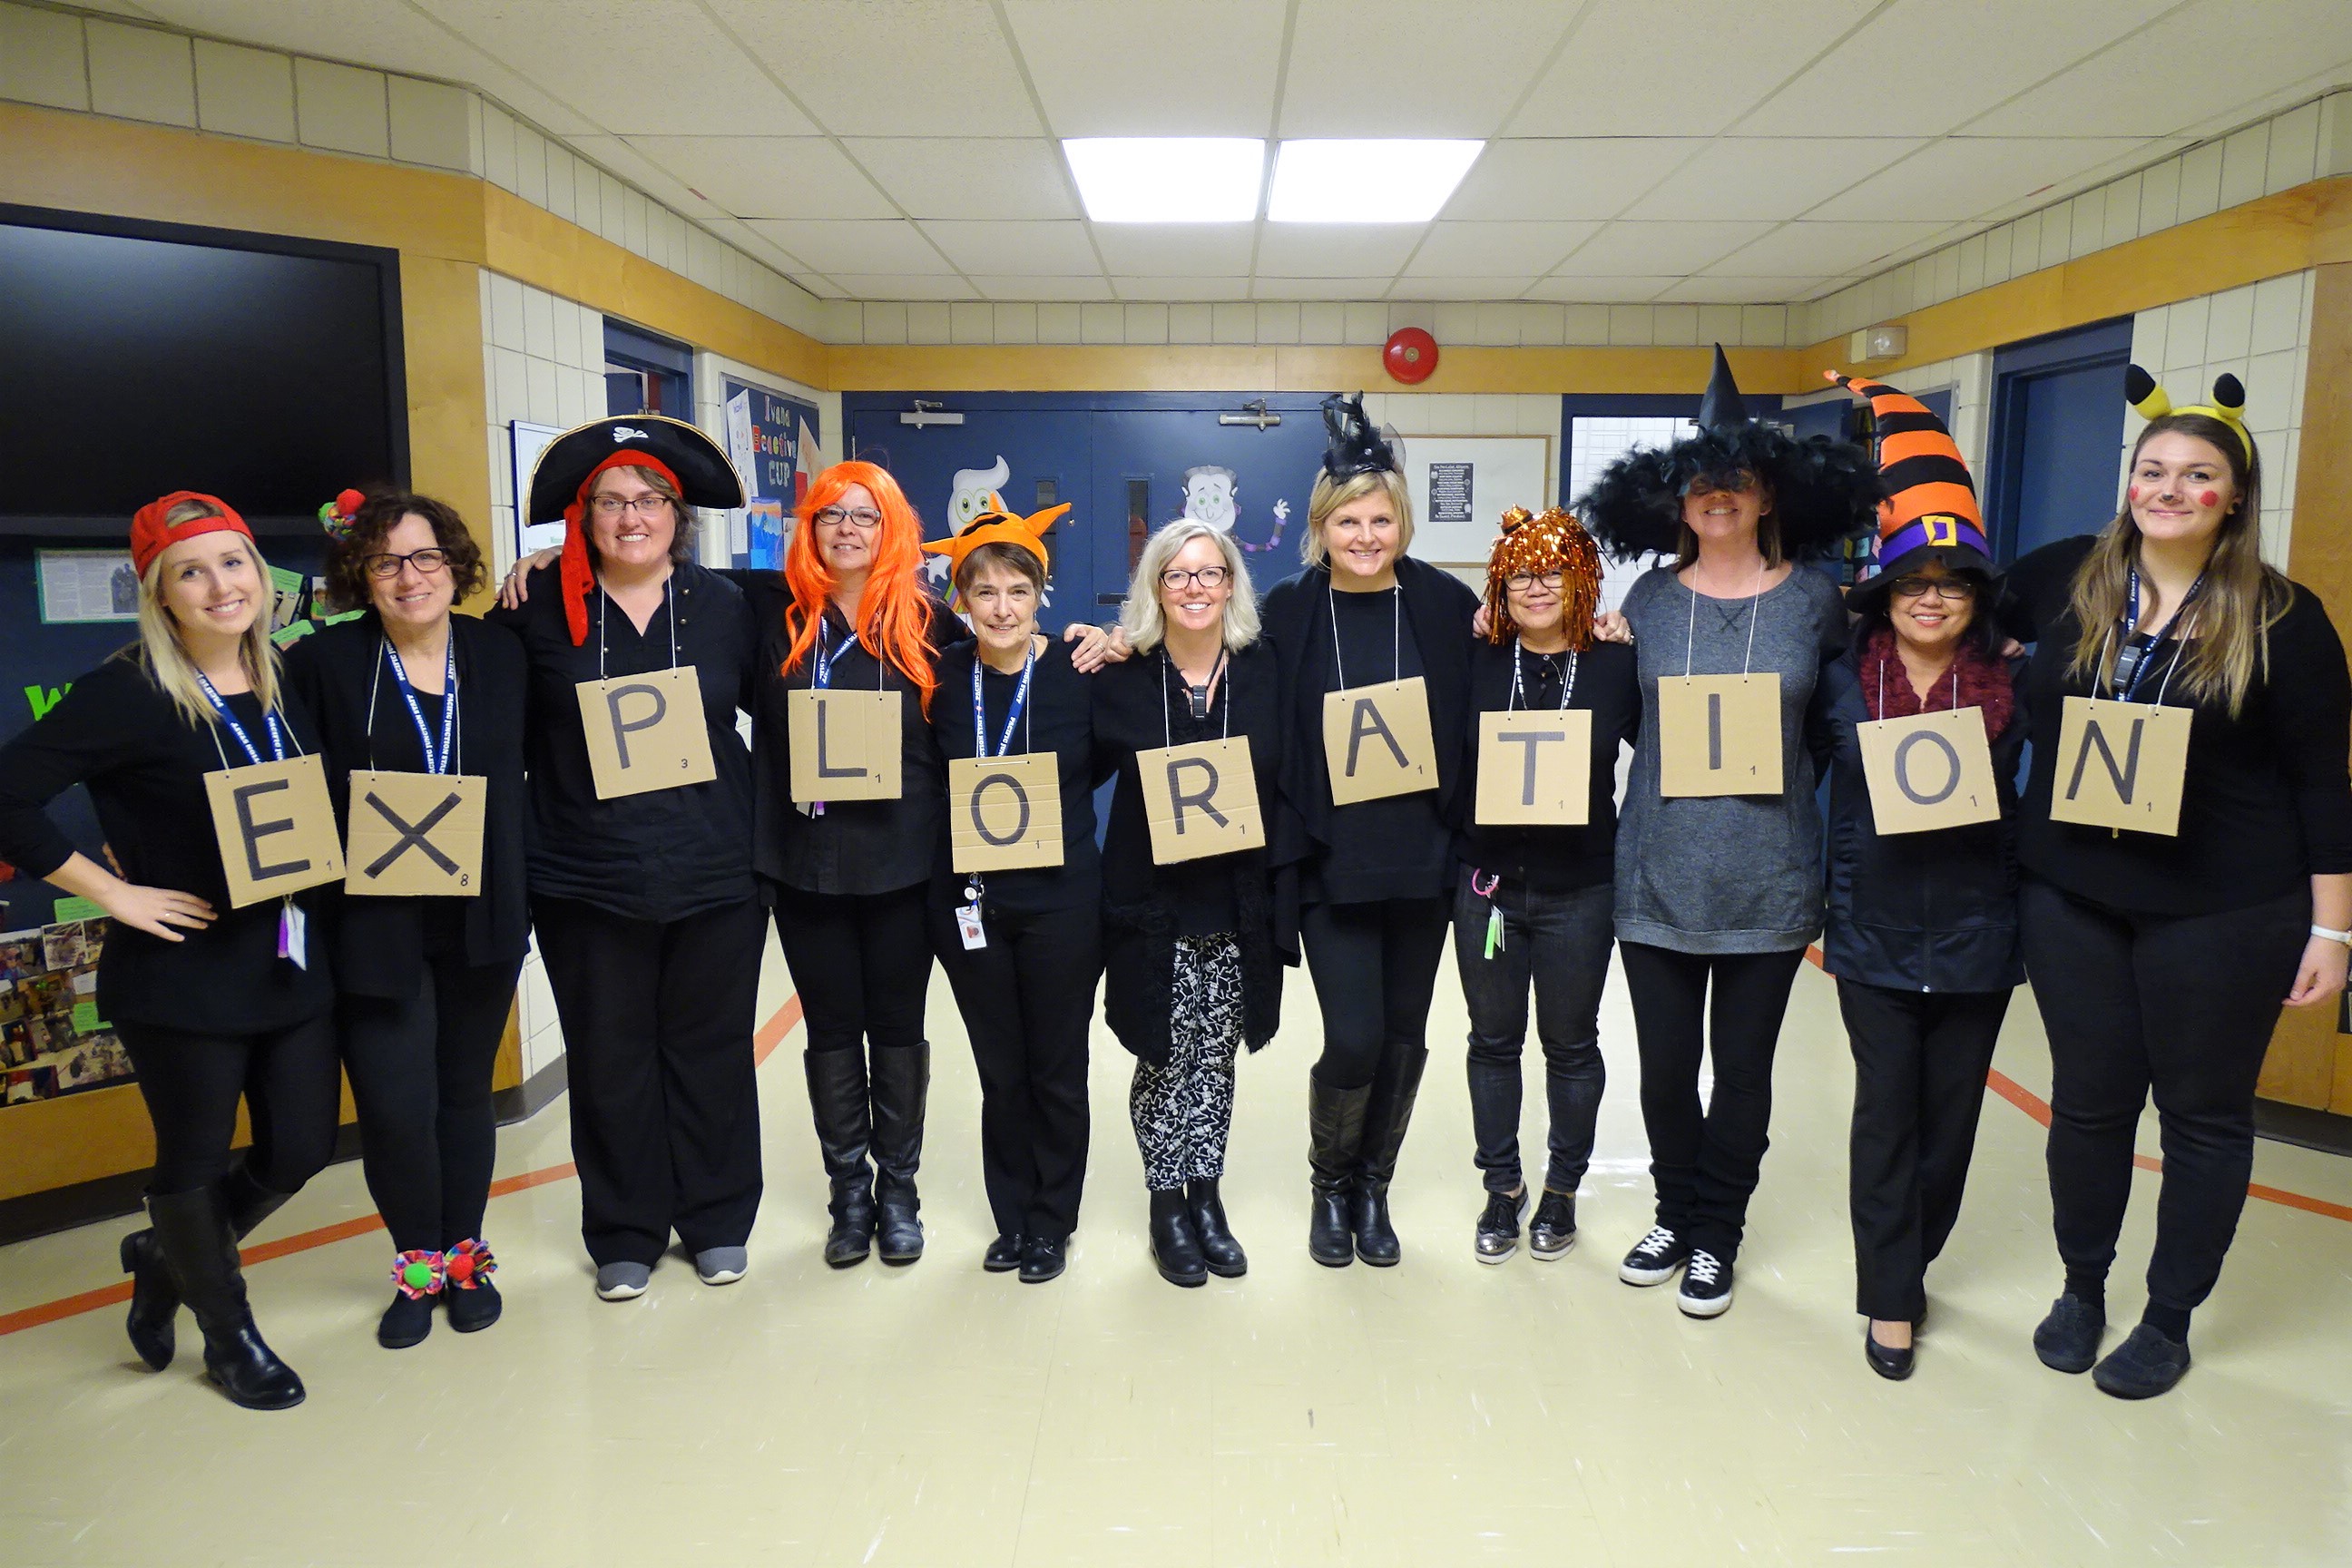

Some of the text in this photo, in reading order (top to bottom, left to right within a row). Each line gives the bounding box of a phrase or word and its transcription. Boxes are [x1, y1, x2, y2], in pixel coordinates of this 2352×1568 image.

[769, 460, 790, 487] CUP
[389, 654, 407, 681] PACIFIC
[406, 694, 420, 715] STAFF
[446, 693, 454, 720] PACIFIC
[1016, 683, 1027, 704] STAFF
[230, 722, 250, 745] STAFF
[268, 717, 281, 749] PACIFIC
[415, 714, 434, 750] JUNCTION
[441, 720, 453, 755] JUNCTION
[605, 684, 667, 770] P
[818, 700, 868, 779] L
[1002, 717, 1016, 743] PACIFIC
[1345, 698, 1410, 778] A
[1708, 692, 1722, 770] I
[681, 758, 689, 769] 3
[1416, 764, 1423, 775] 1
[1497, 730, 1565, 806] T
[1749, 765, 1756, 776] 1
[1894, 730, 1962, 806] O
[2064, 718, 2145, 805] N
[874, 773, 881, 784] 1
[1166, 757, 1230, 836] R
[1558, 799, 1564, 810] 1
[1969, 794, 1978, 808] 1
[2146, 801, 2152, 812] 1
[970, 773, 1031, 848] O
[232, 779, 311, 882] E
[363, 790, 463, 880] X
[1239, 824, 1246, 835] 1
[1034, 839, 1041, 849] 1
[325, 859, 332, 871] 1
[460, 873, 469, 887] 8
